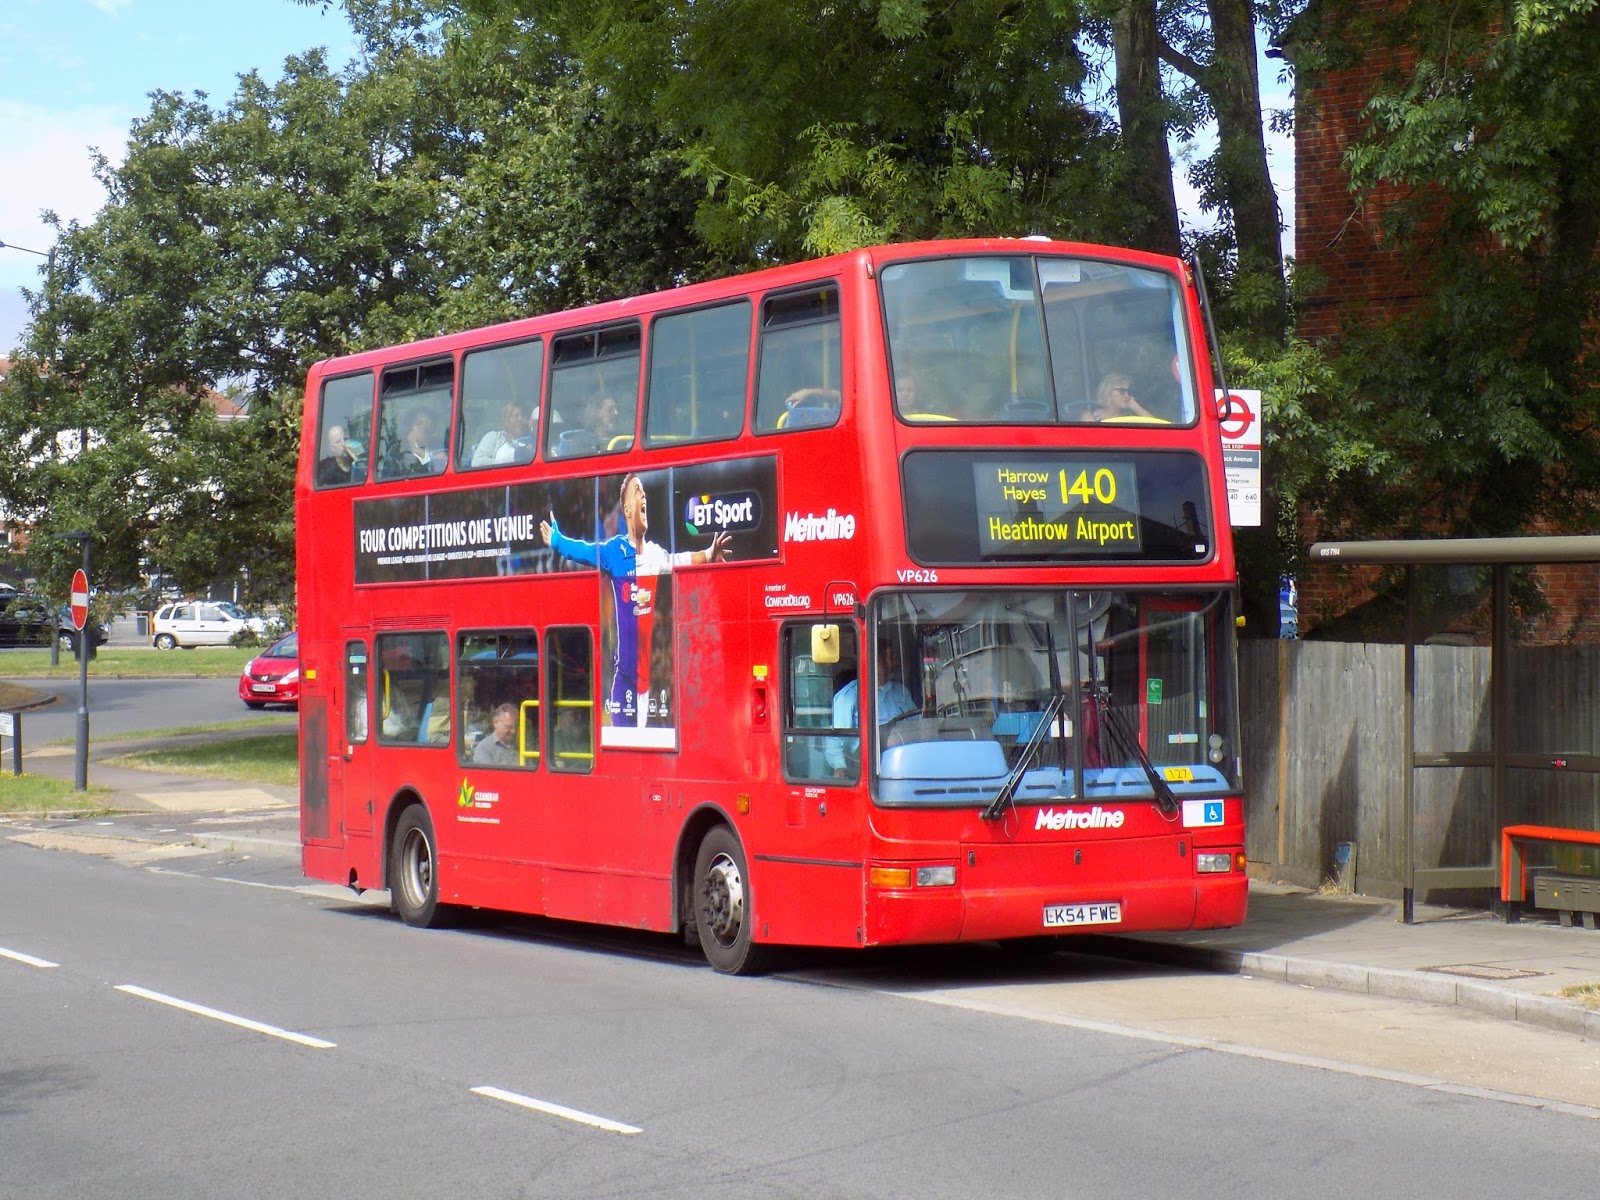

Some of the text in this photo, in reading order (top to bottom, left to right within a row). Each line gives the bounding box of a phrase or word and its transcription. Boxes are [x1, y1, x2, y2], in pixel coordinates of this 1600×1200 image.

[998, 469, 1049, 484] Harrow
[1059, 468, 1116, 504] 140
[1004, 485, 1047, 502] Hayes
[694, 497, 753, 529] BT Sport
[360, 514, 534, 553] FOUR COMPETITIONS ONE VENUE
[784, 508, 856, 542] Metroline
[989, 516, 1135, 546] Heathrow Airport
[897, 570, 938, 583] VP626
[833, 593, 854, 606] VP626
[1170, 769, 1187, 779] 127
[1034, 807, 1125, 830] Metroline
[1045, 906, 1118, 924] LK54 FWE
